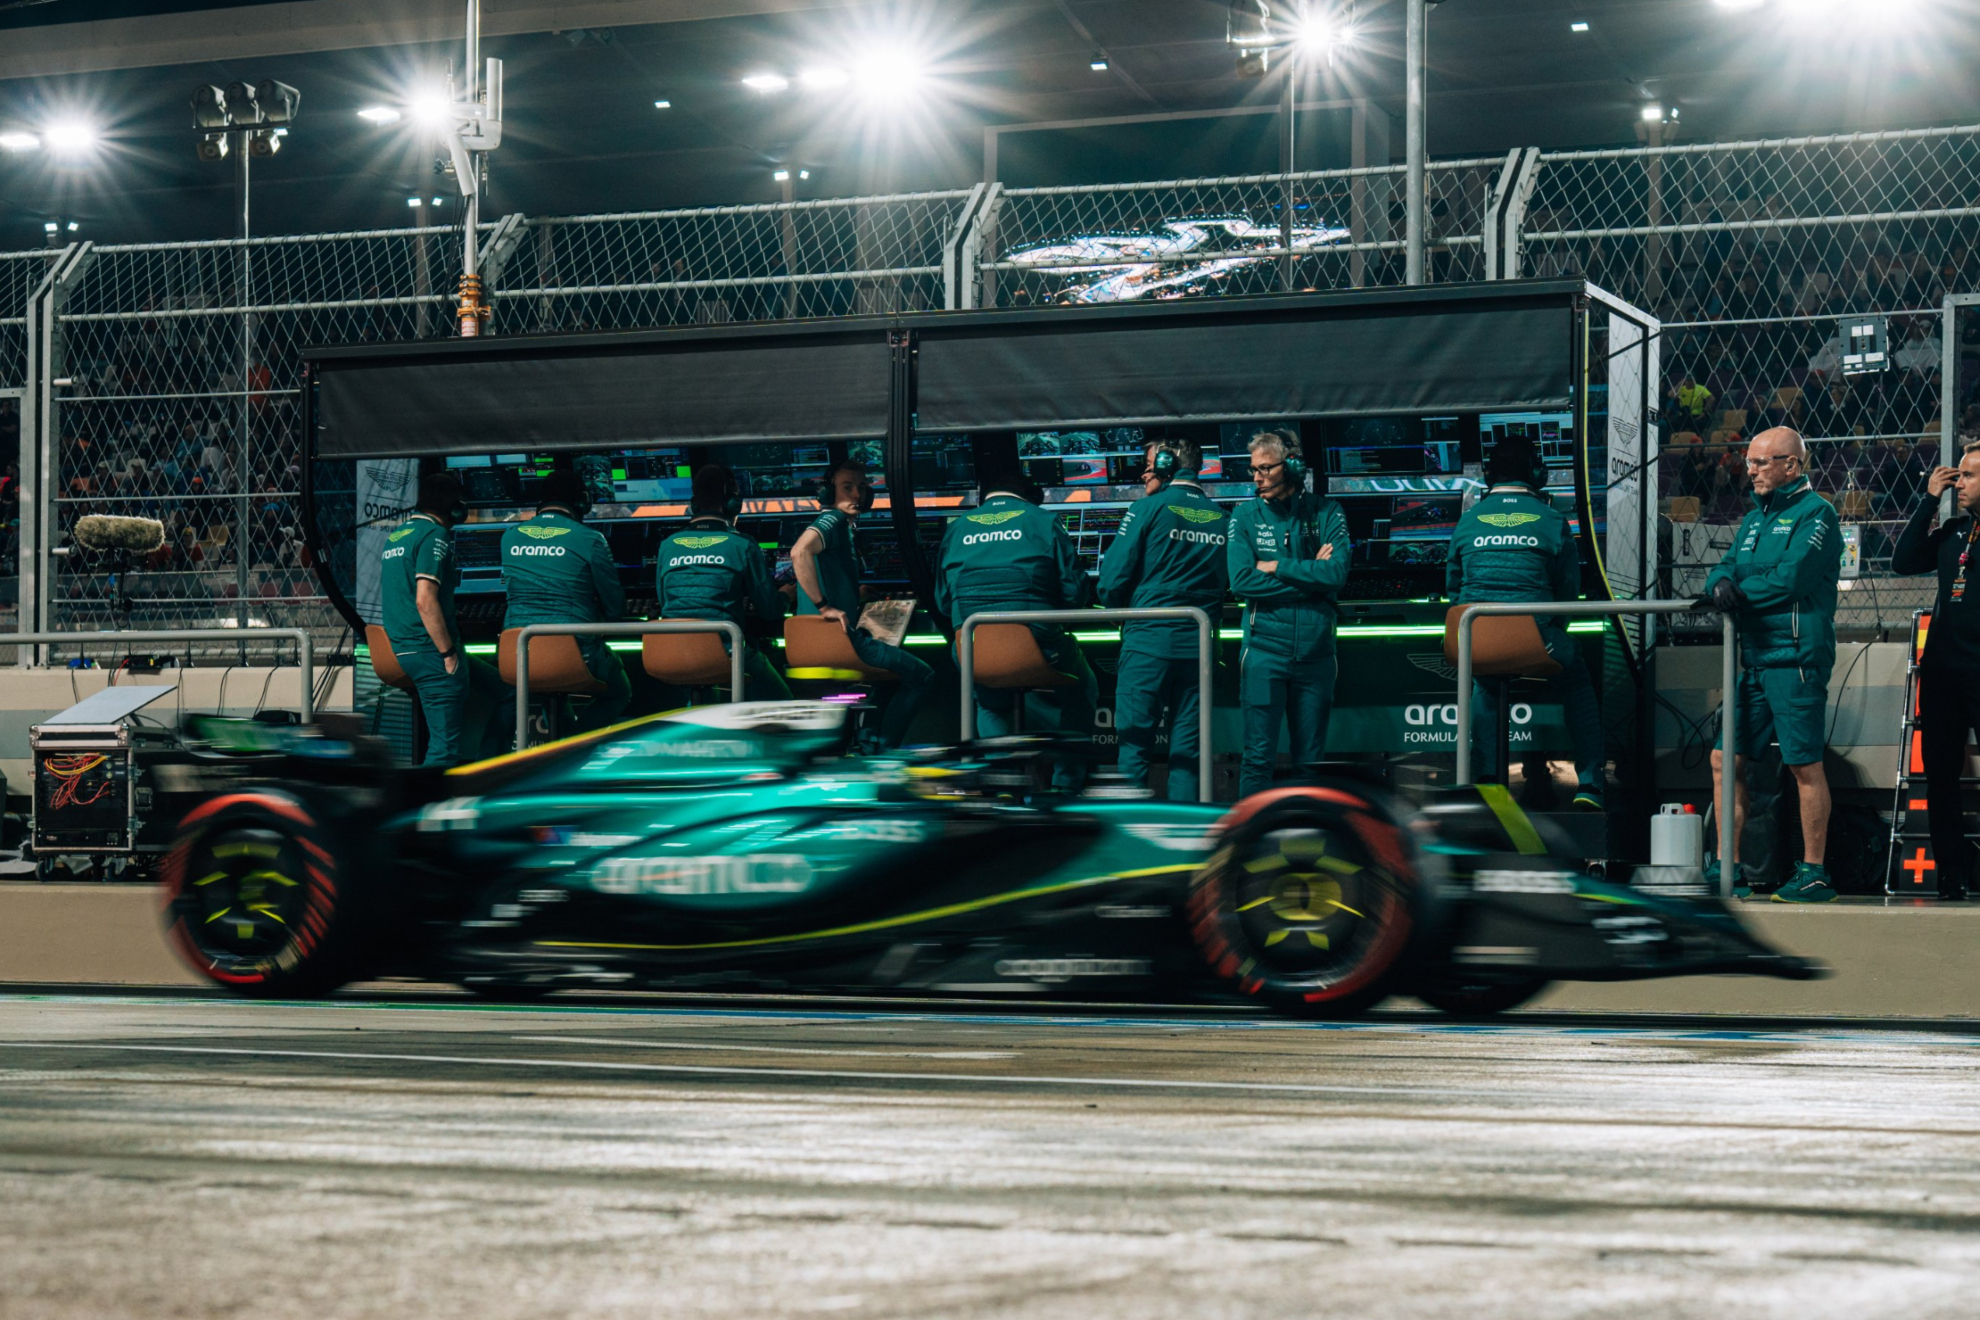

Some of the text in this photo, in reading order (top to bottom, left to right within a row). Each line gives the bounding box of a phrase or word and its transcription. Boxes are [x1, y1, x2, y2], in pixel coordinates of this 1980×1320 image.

[963, 529, 1022, 545] aramco
[1169, 528, 1226, 546] aramco
[1473, 535, 1539, 547] aramco
[381, 546, 405, 560] ramco
[510, 545, 566, 557] aramco
[669, 554, 725, 566] aramco
[1404, 703, 1533, 725] arao
[1508, 731, 1532, 741] EAM
